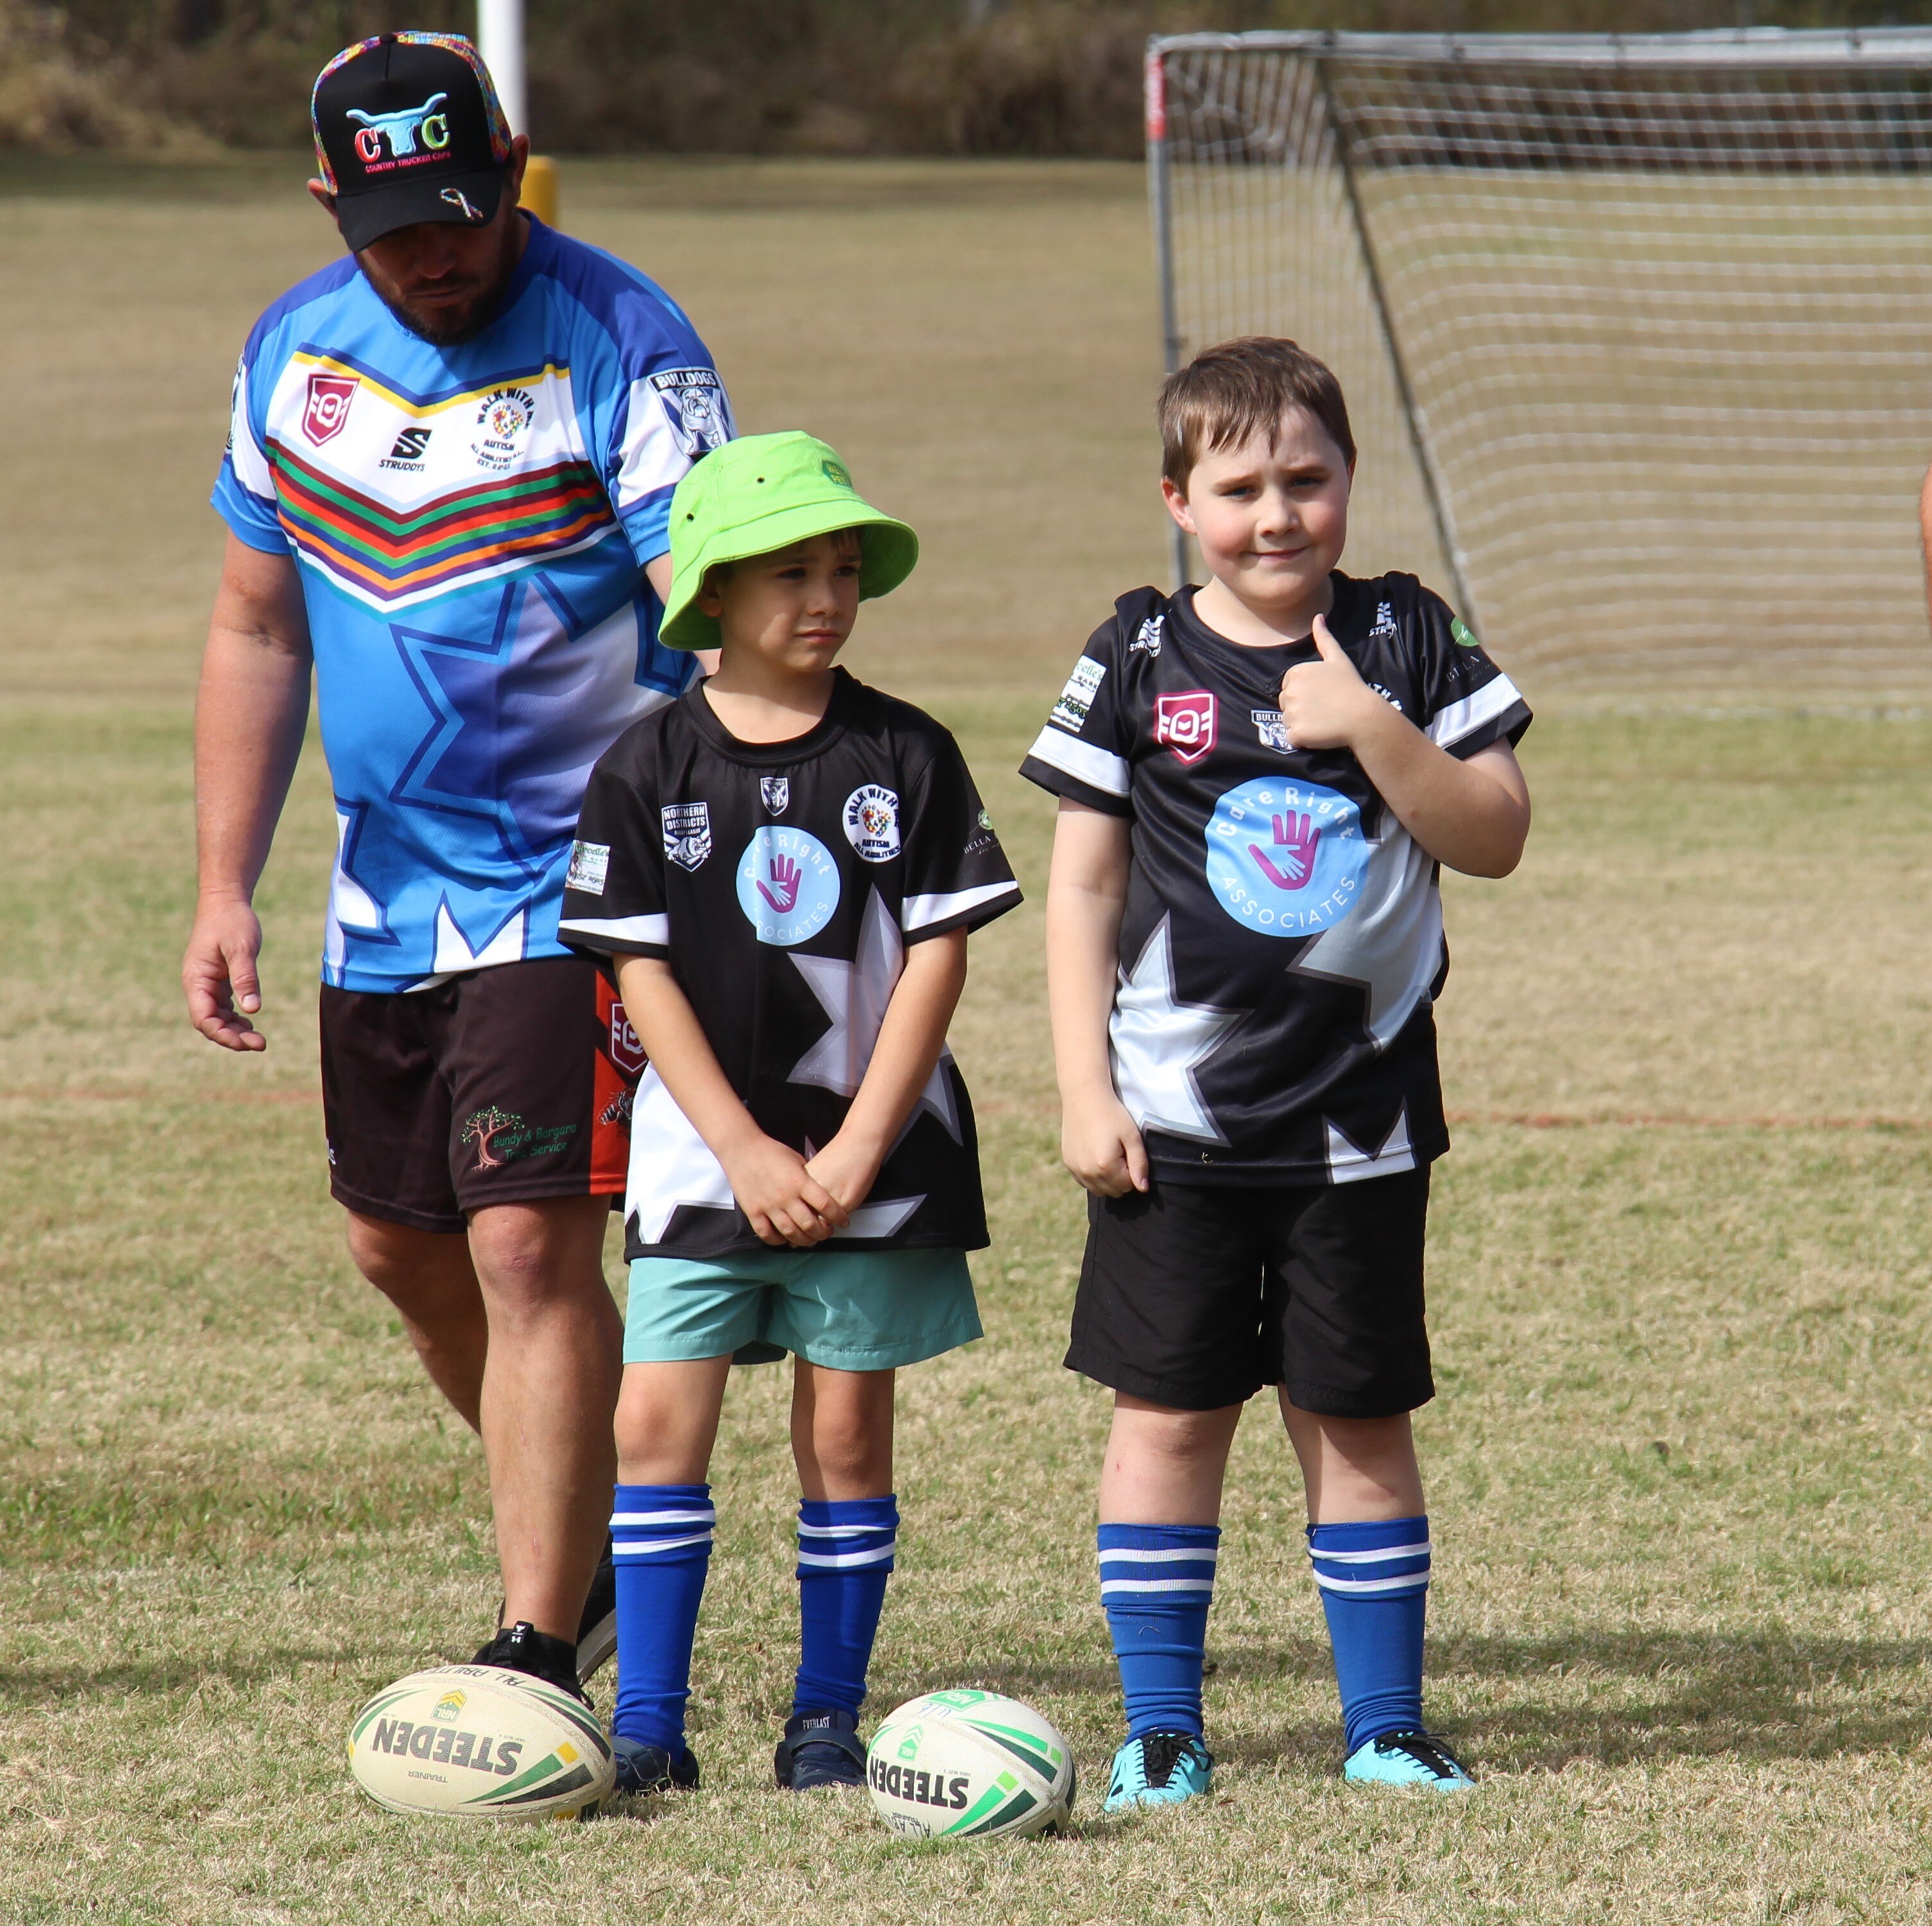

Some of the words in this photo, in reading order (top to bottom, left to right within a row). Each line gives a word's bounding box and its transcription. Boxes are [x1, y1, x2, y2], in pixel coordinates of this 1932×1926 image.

[365, 161, 395, 173] COUNTRY
[398, 154, 431, 167] TRUCKER
[655, 371, 716, 389] BULLDOGS
[477, 389, 504, 424] WALK
[506, 387, 535, 409] WITH
[484, 439, 515, 451] AUTISM
[378, 459, 426, 472] STRUDDYS
[1256, 713, 1283, 722] BULLD
[663, 805, 705, 820] NORTHERN
[848, 791, 867, 825] WALK
[868, 788, 898, 807] WITH
[1216, 790, 1274, 837] Care
[1285, 787, 1355, 840] Right
[666, 816, 705, 830] DISTRICTS
[854, 842, 864, 854] ALL
[865, 844, 901, 858] ABILITIES
[862, 839, 890, 848] AUTISM
[963, 835, 991, 854] BELLA
[778, 834, 831, 875] Right
[1222, 876, 1355, 928] ASSOCIATES
[494, 1131, 522, 1148] Bundy
[524, 1130, 532, 1141] &
[537, 1124, 576, 1140] Bargara
[531, 1141, 567, 1156] Service
[495, 1672, 526, 1687] ALL
[436, 1708, 457, 1719] NRL
[803, 1715, 830, 1730] EVERLAST
[372, 1718, 522, 1777] STEEDEN
[900, 1746, 915, 1757] NRL
[408, 1770, 448, 1784] TRAINER
[869, 1755, 969, 1810] STEEDEN
[910, 1823, 931, 1839] ALL
